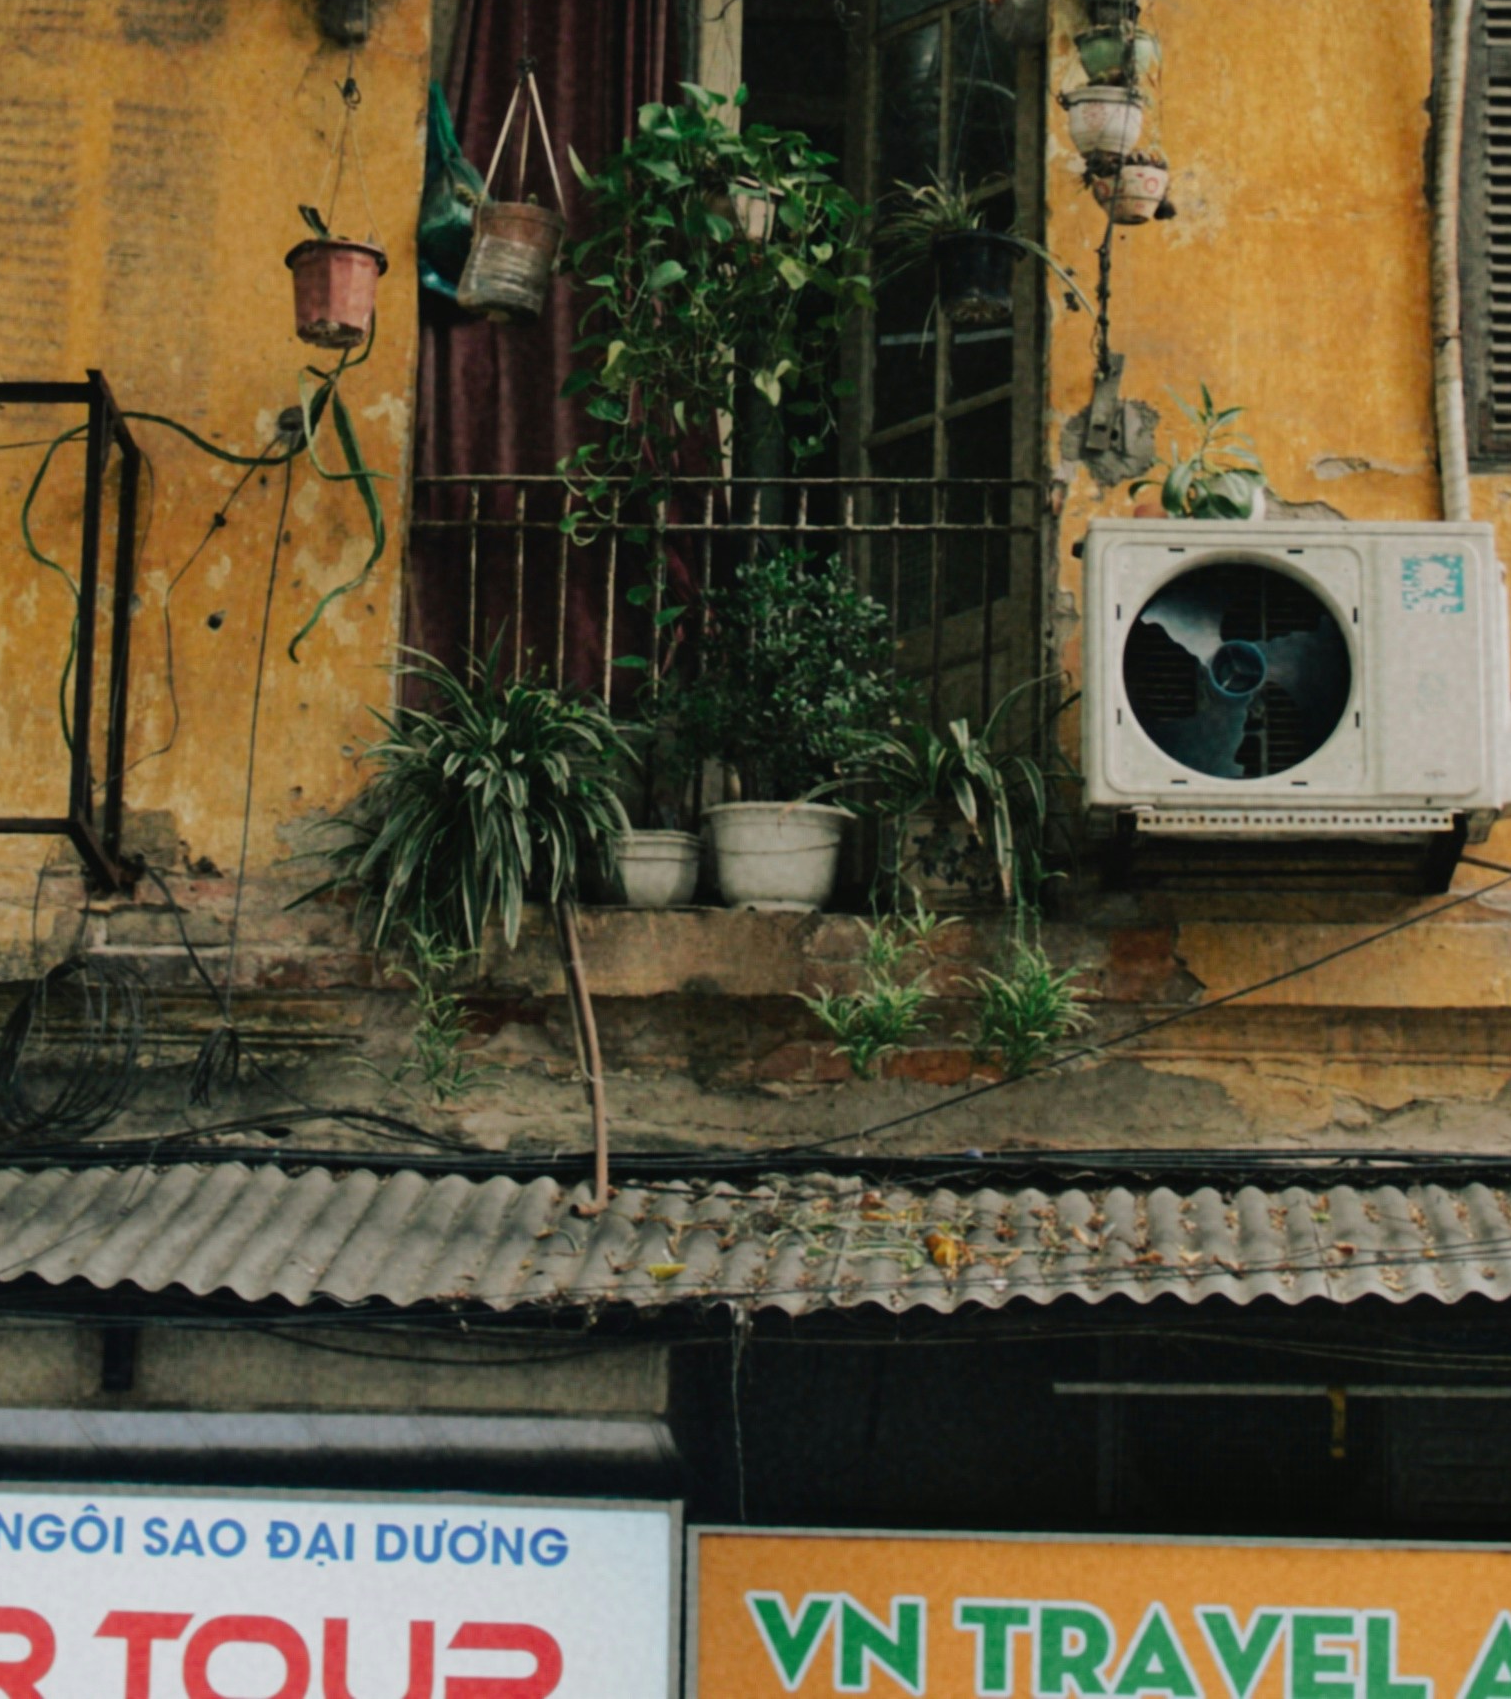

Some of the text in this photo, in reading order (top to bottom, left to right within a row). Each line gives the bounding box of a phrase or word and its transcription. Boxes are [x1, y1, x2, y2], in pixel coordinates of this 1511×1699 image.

[143, 1516, 247, 1559] SAO
[265, 1520, 355, 1567] ĐẠI
[375, 1520, 570, 1567] DƯƠNG
[97, 1610, 564, 1699] TOUR
[749, 1594, 925, 1694] VN
[956, 1601, 1432, 1699] TRAVEL
